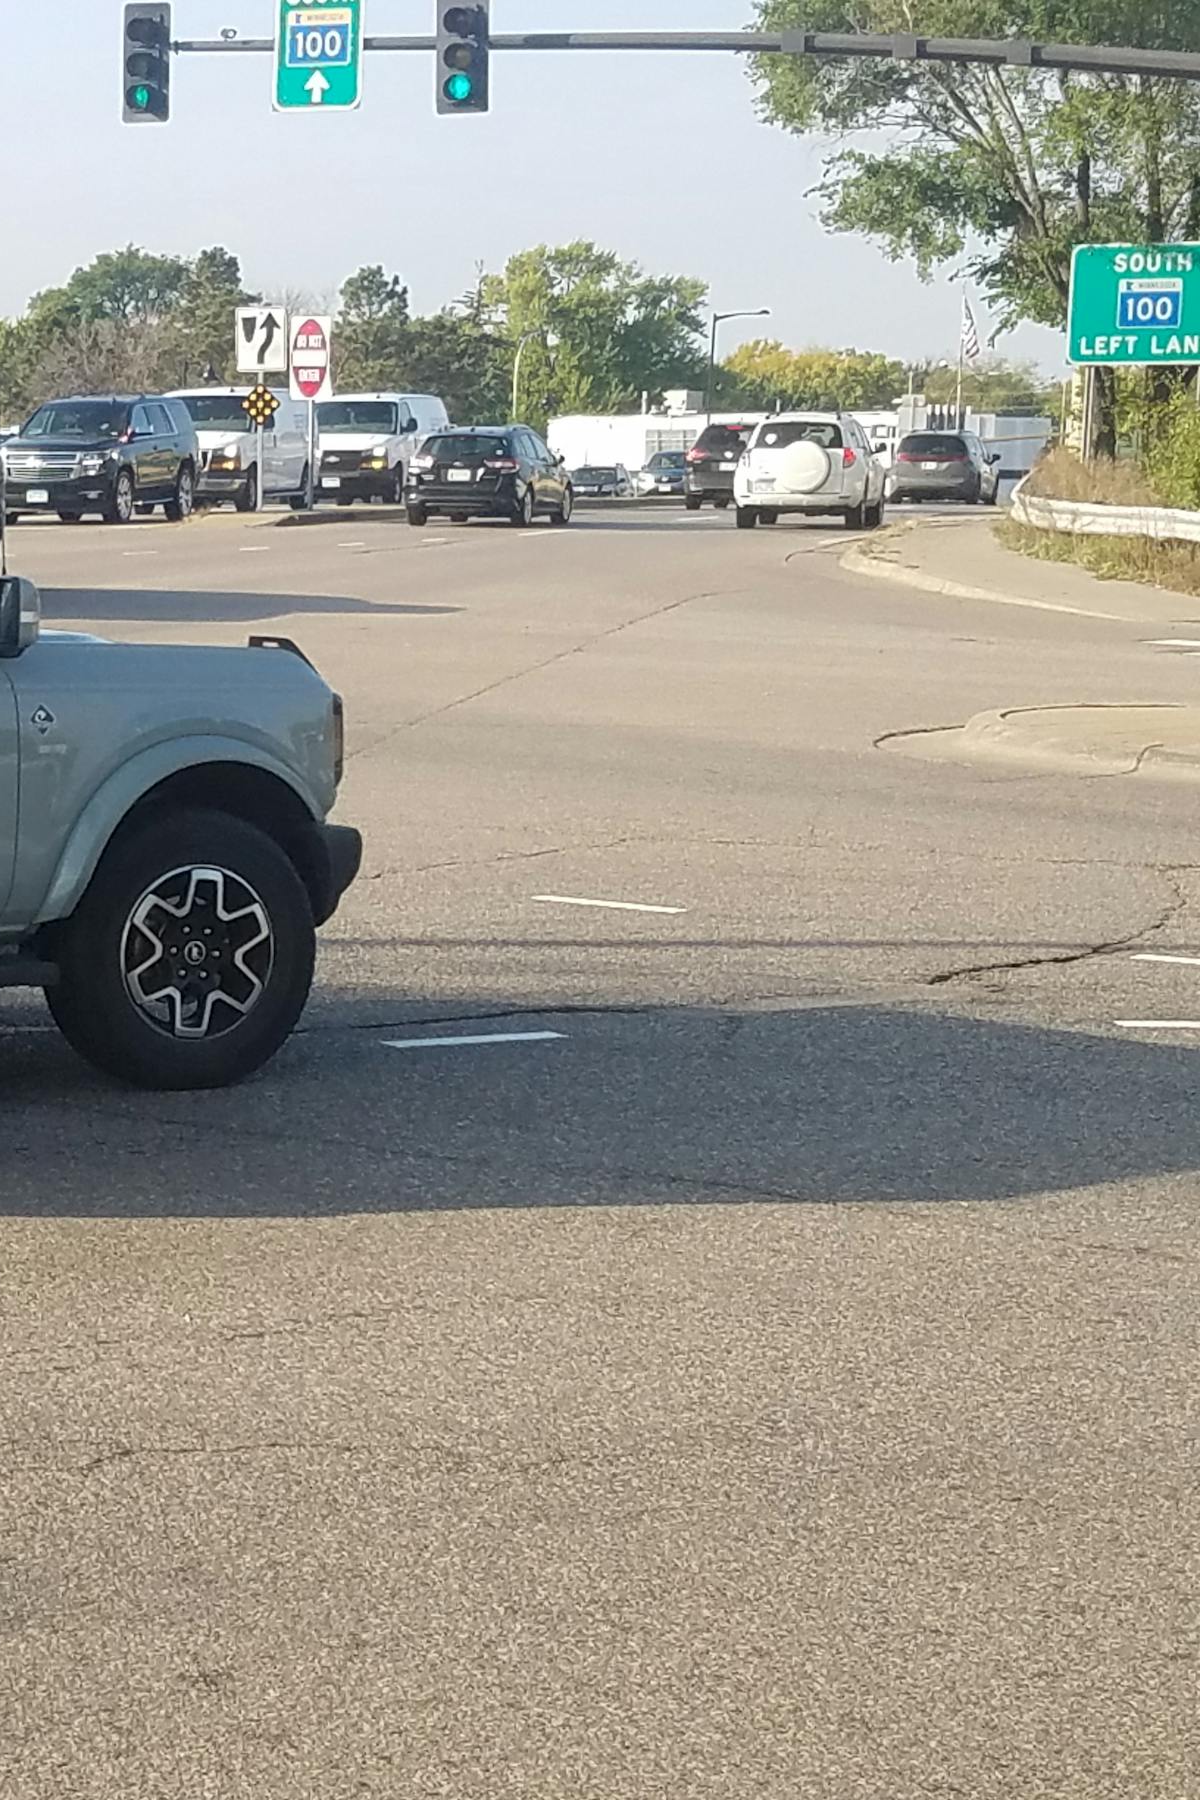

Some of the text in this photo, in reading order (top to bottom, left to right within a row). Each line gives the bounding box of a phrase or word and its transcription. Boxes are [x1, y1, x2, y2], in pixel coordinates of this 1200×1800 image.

[296, 30, 341, 58] 100
[1113, 252, 1192, 273] SOUTH
[1126, 297, 1172, 321] 100
[1080, 336, 1138, 355] LEFT
